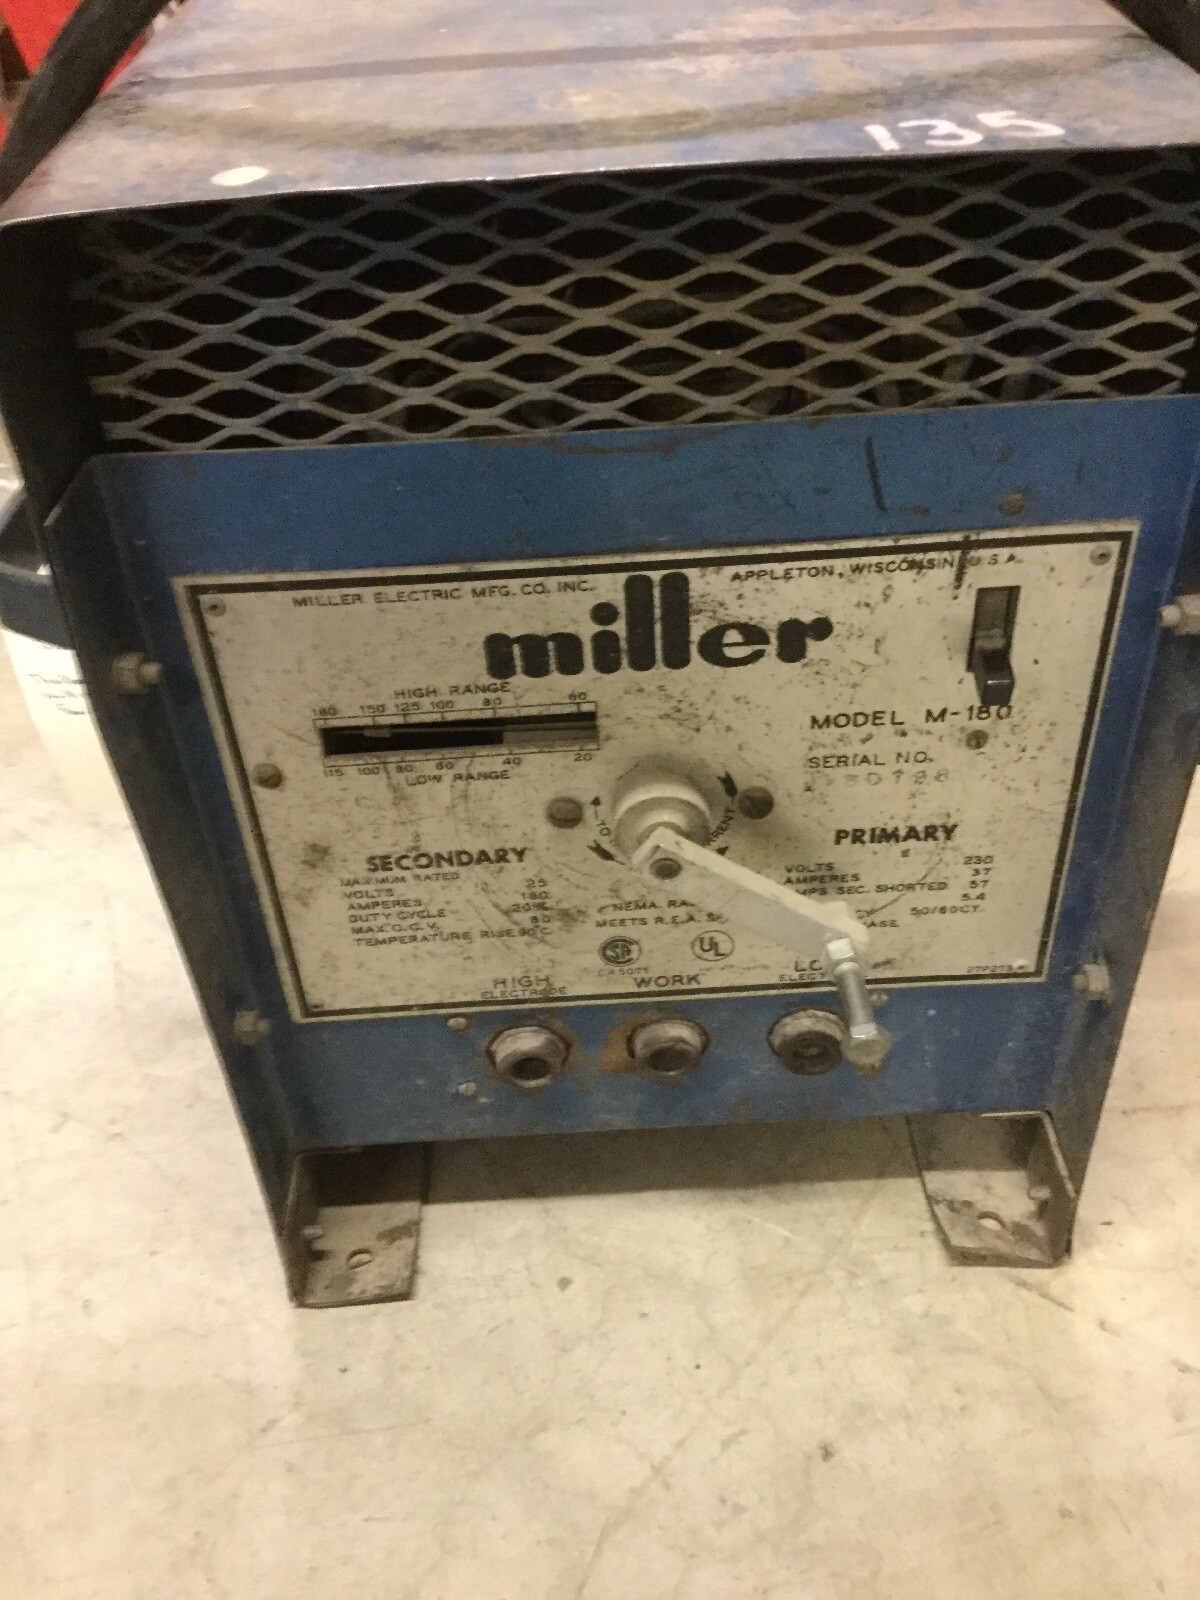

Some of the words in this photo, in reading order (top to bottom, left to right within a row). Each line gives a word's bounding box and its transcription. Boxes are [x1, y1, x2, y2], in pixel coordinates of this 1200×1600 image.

[864, 110, 1066, 151] 135
[849, 556, 954, 575] WISCONSIN
[293, 592, 362, 607] MILLER
[374, 587, 461, 604] ELECTRIC
[471, 585, 516, 598] MFG.
[556, 580, 595, 593] INC.
[484, 571, 833, 680] miller
[394, 686, 437, 700] HIGH
[450, 681, 510, 695] RANGE
[431, 699, 454, 712] 100
[810, 710, 904, 730] MODEL
[502, 756, 522, 767] 40
[574, 752, 593, 763] 20
[807, 752, 886, 769] SERIAL
[405, 773, 442, 787] LOW
[453, 769, 511, 783] RANGE
[834, 824, 959, 846] PRIMARY
[366, 847, 528, 873] SECONDARY
[785, 862, 836, 873] VOLTS
[412, 871, 460, 883] RATED
[784, 873, 860, 885] AMPERES
[343, 887, 395, 900] VOLTS
[795, 886, 828, 897] MPS
[875, 881, 948, 894] SHORTED
[347, 899, 423, 911] AMPERES
[348, 912, 392, 924] DUTY
[396, 908, 446, 921] CYCLE
[595, 917, 648, 929] MEETS
[861, 919, 899, 930] ASE
[354, 930, 473, 947] TEMPERATURE
[480, 928, 515, 939] RISE
[492, 975, 551, 989] HIGH
[632, 973, 701, 989] WORK
[779, 971, 828, 983] ELECT
